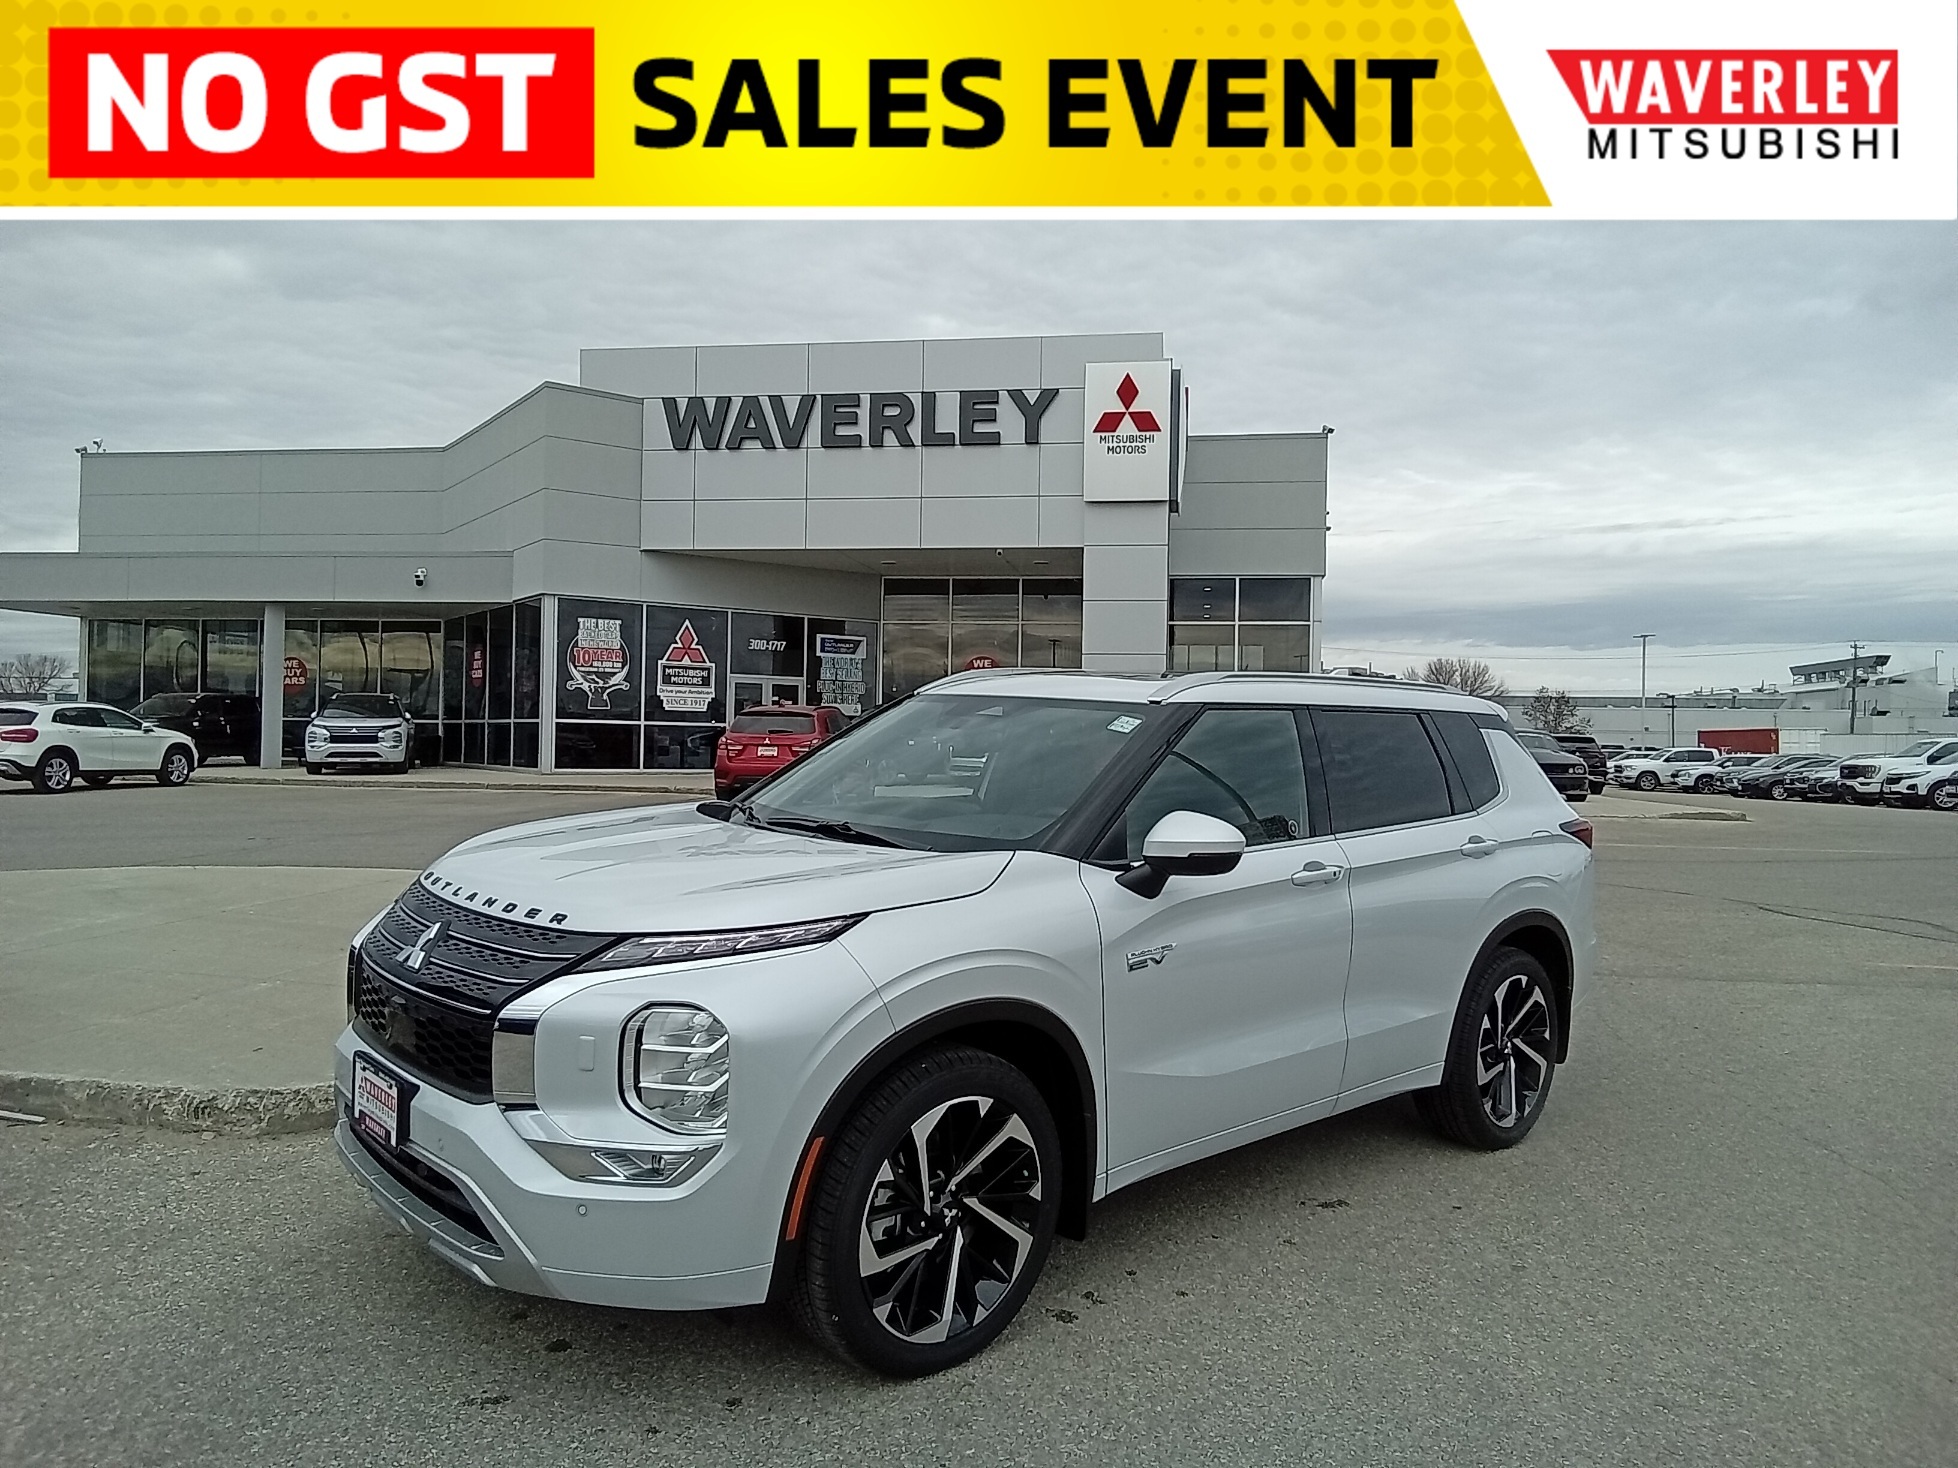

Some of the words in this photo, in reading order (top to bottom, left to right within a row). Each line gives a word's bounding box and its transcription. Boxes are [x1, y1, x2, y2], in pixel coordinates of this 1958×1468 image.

[661, 389, 1060, 450] WAVERLEY
[1099, 434, 1155, 444] MITSUBISHI
[1107, 445, 1147, 455] MOTORS
[578, 617, 597, 630] THE
[598, 618, 622, 631] BEST
[748, 638, 787, 651] 300-1717
[574, 648, 592, 666] 10
[592, 649, 622, 661] YEAR
[283, 660, 300, 668] WE
[972, 659, 992, 668] WE
[665, 668, 708, 677] MITSUBISHI
[283, 677, 306, 685] ARS
[670, 676, 703, 685] MOTORS
[665, 698, 689, 706] SINCE
[690, 699, 707, 707] 1917
[423, 870, 569, 926] OUTLANDER
[365, 1079, 396, 1112] WAVERLEY
